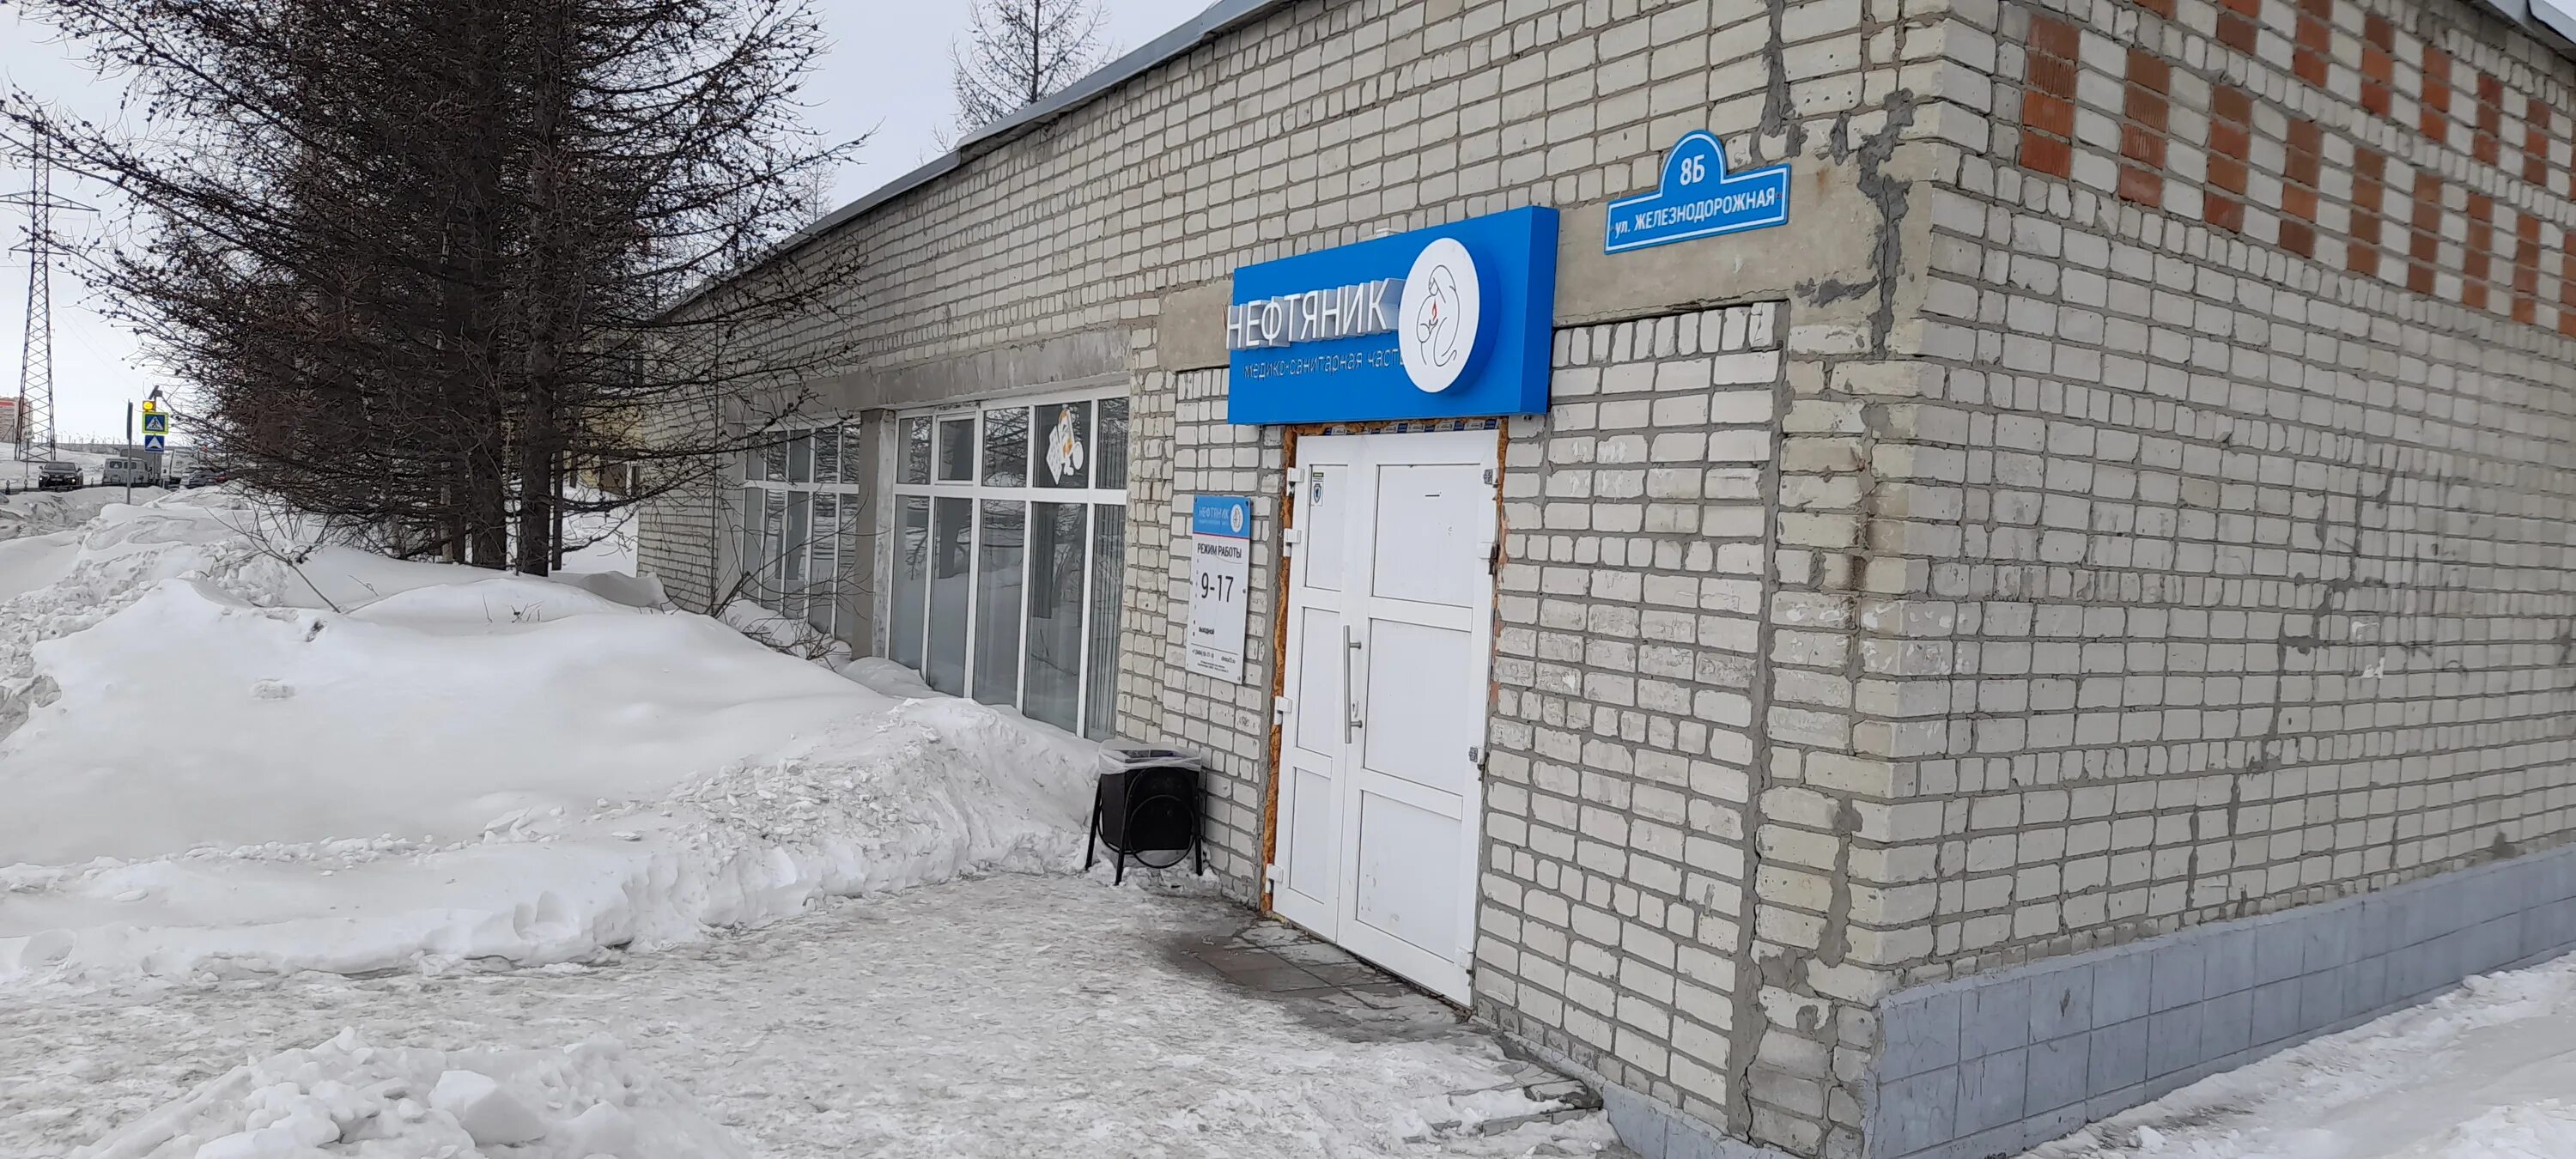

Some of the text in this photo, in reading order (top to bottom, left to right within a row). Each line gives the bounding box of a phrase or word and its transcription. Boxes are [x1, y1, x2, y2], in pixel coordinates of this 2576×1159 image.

[1680, 154, 1705, 186] 8Б
[1615, 186, 1776, 239] ул. ЖЕЛЕЗНОДОРОЖНАЯ
[1225, 278, 1389, 350] НЕФТЯНИК
[1244, 352, 1363, 380] медико-санитарная
[1197, 543, 1242, 559] РЕЖИМ РАБОТЫ
[1201, 572, 1234, 603] 9-17
